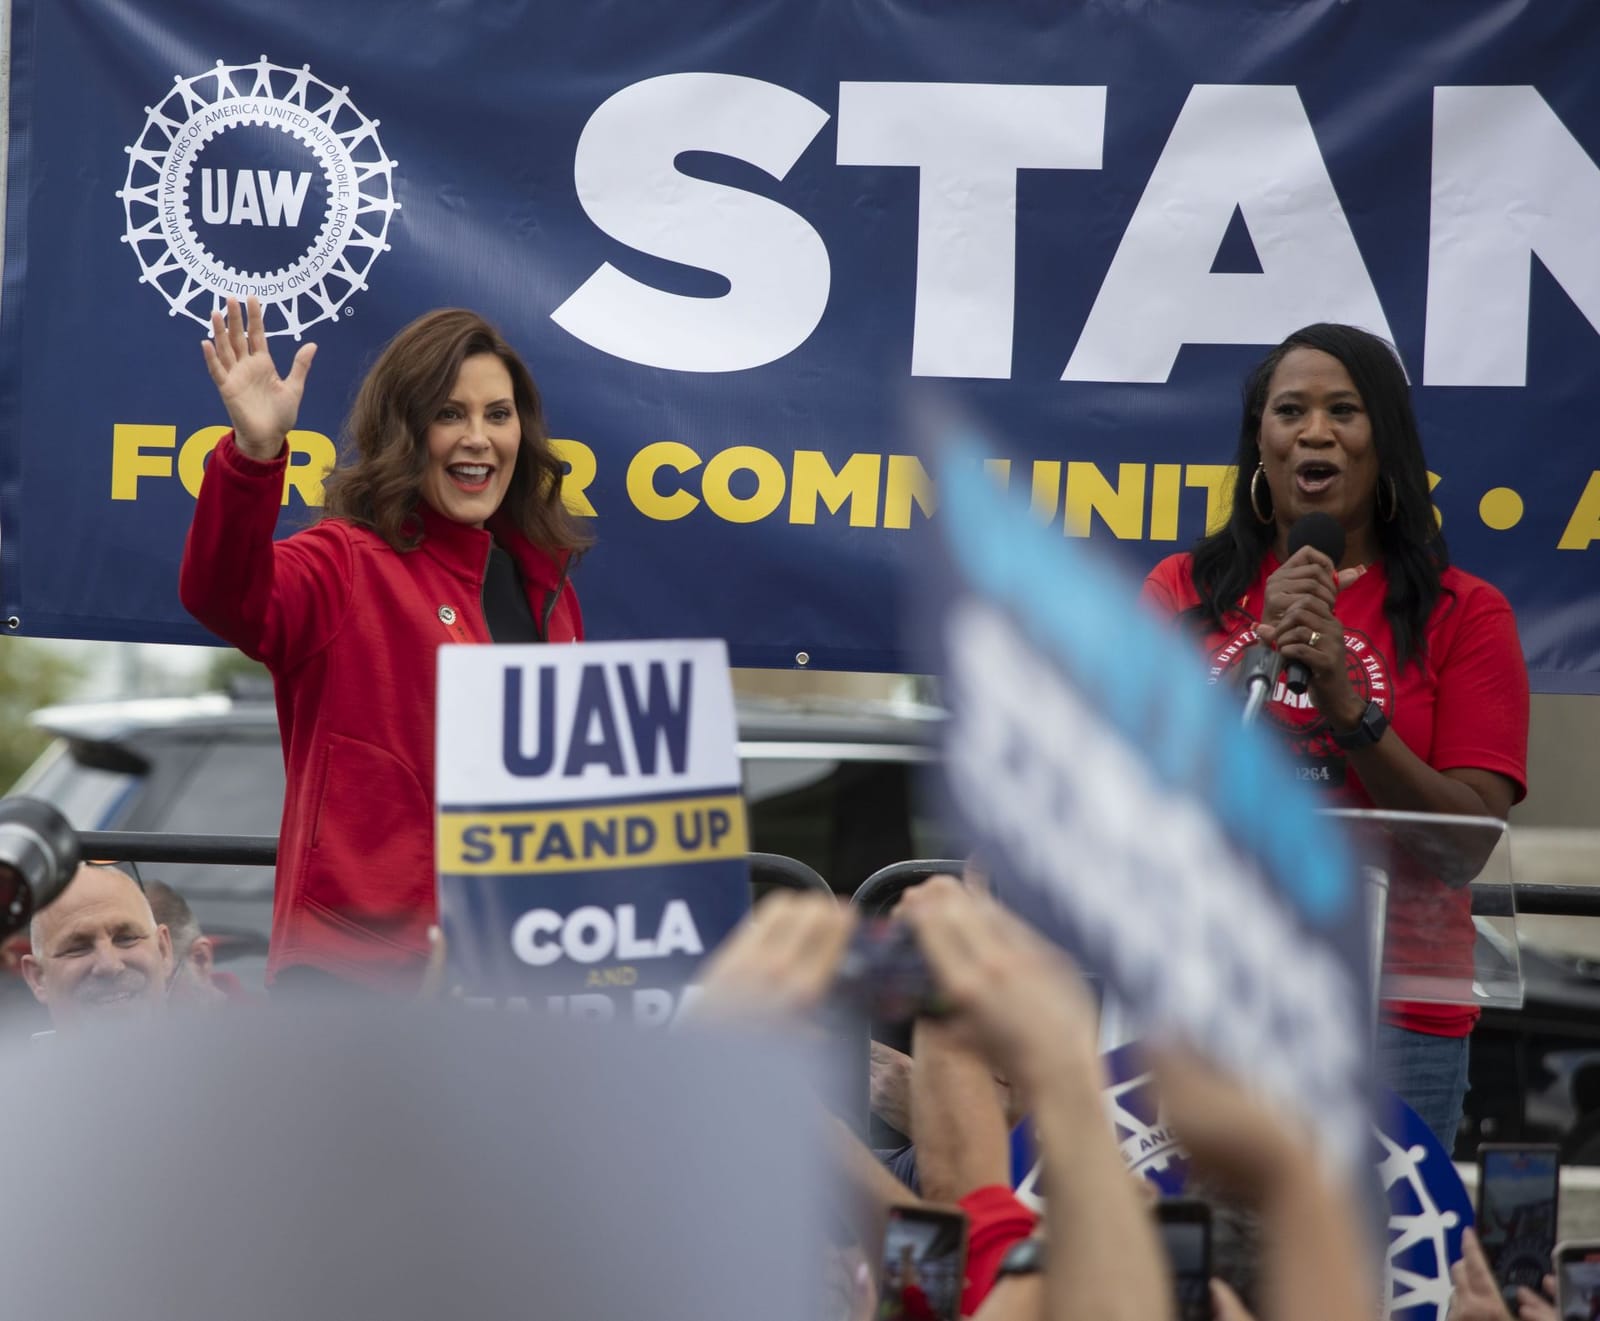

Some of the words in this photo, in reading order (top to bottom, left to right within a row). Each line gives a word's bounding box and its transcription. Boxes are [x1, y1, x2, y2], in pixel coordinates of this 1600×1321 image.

[188, 120, 203, 138] OF
[204, 103, 259, 126] AMERICA
[264, 105, 309, 129] UNITED
[164, 136, 191, 195] WORKERS
[309, 126, 350, 200] AUTOMOBILE,
[201, 168, 312, 227] UAW
[164, 198, 199, 268] IMPLEMENT
[309, 203, 348, 272] AEROSPACE
[550, 72, 1600, 387] STAN
[199, 264, 284, 296] AGRICULTURAL
[287, 267, 311, 289] AND
[626, 441, 1442, 543] COMMUNIT
[1362, 655, 1385, 690] THAN
[502, 660, 693, 778] UAW
[460, 816, 657, 864] STAND
[675, 808, 731, 851] UP
[511, 899, 704, 966] COLA
[585, 966, 640, 988] AND
